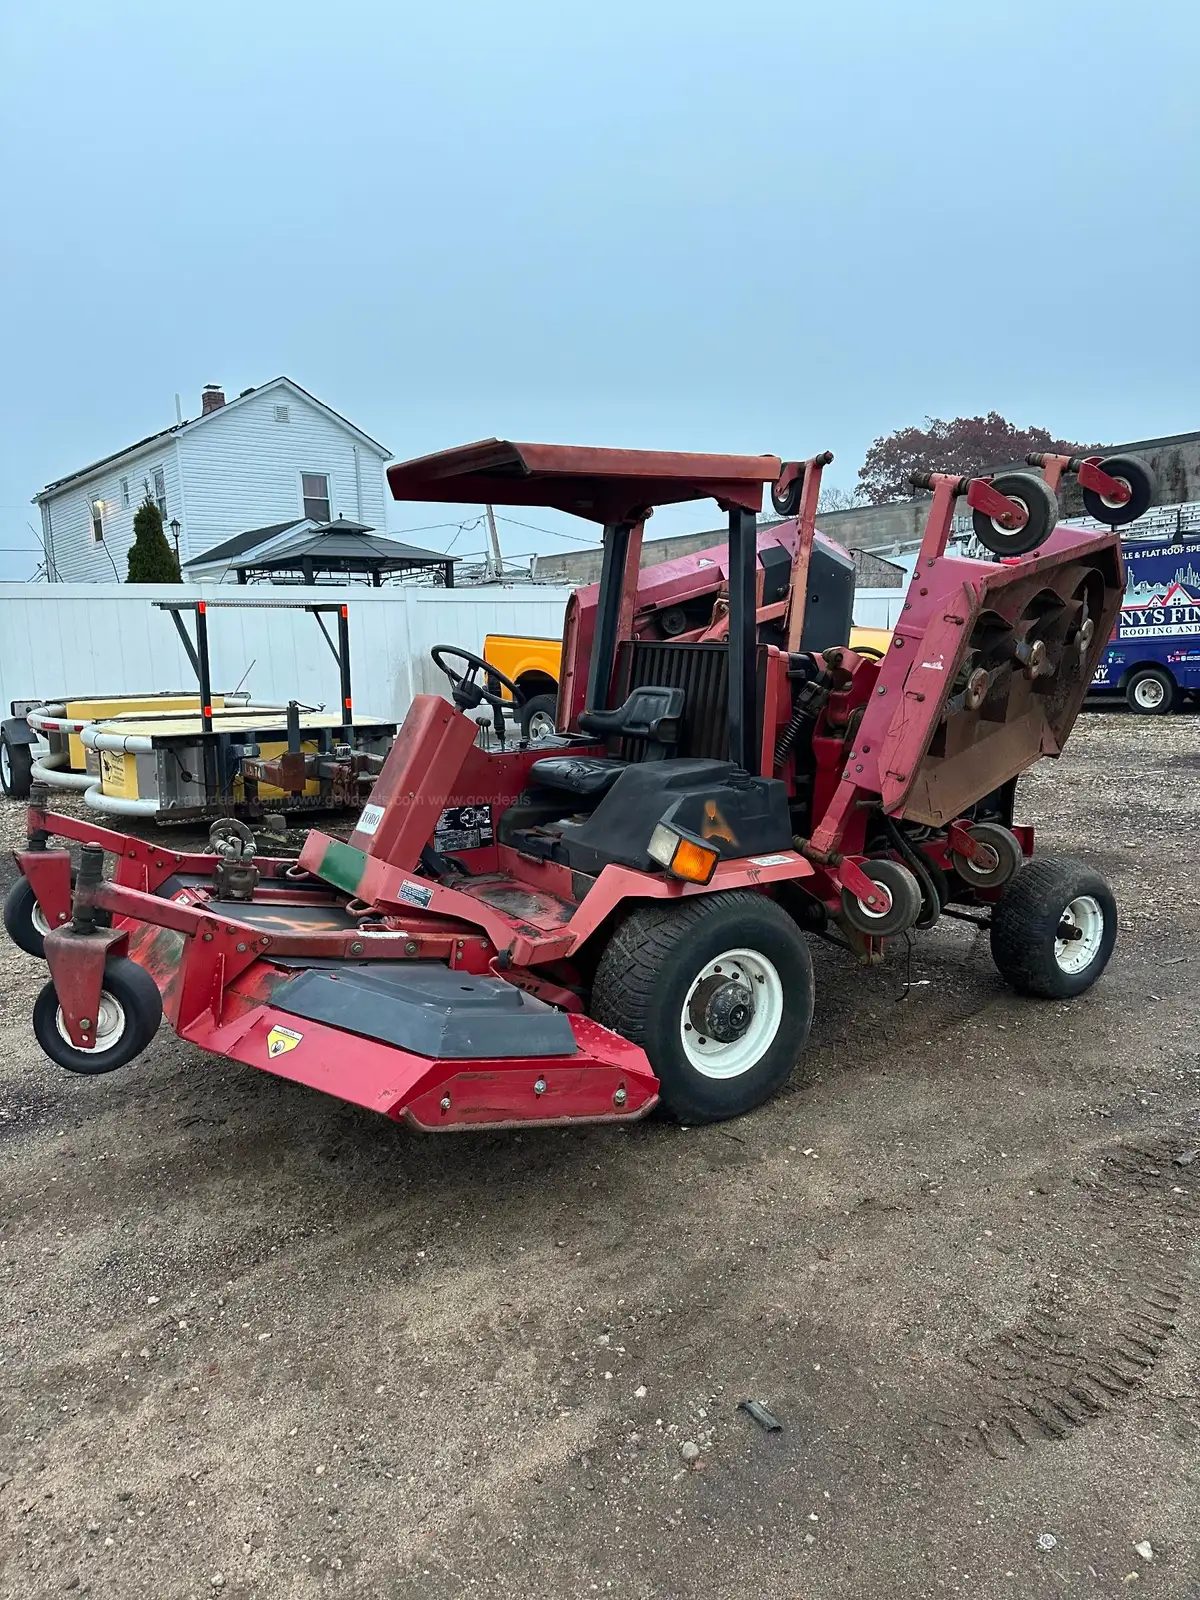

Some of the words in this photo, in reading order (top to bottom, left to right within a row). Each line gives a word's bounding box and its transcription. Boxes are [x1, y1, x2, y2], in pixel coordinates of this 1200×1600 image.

[1134, 551, 1140, 559] &
[1142, 549, 1161, 558] FLAT
[1162, 546, 1184, 556] ROOF
[1119, 608, 1165, 626] NY'S
[1122, 626, 1172, 636] ROOFING
[1176, 625, 1200, 633] AND
[361, 811, 380, 826] TORO
